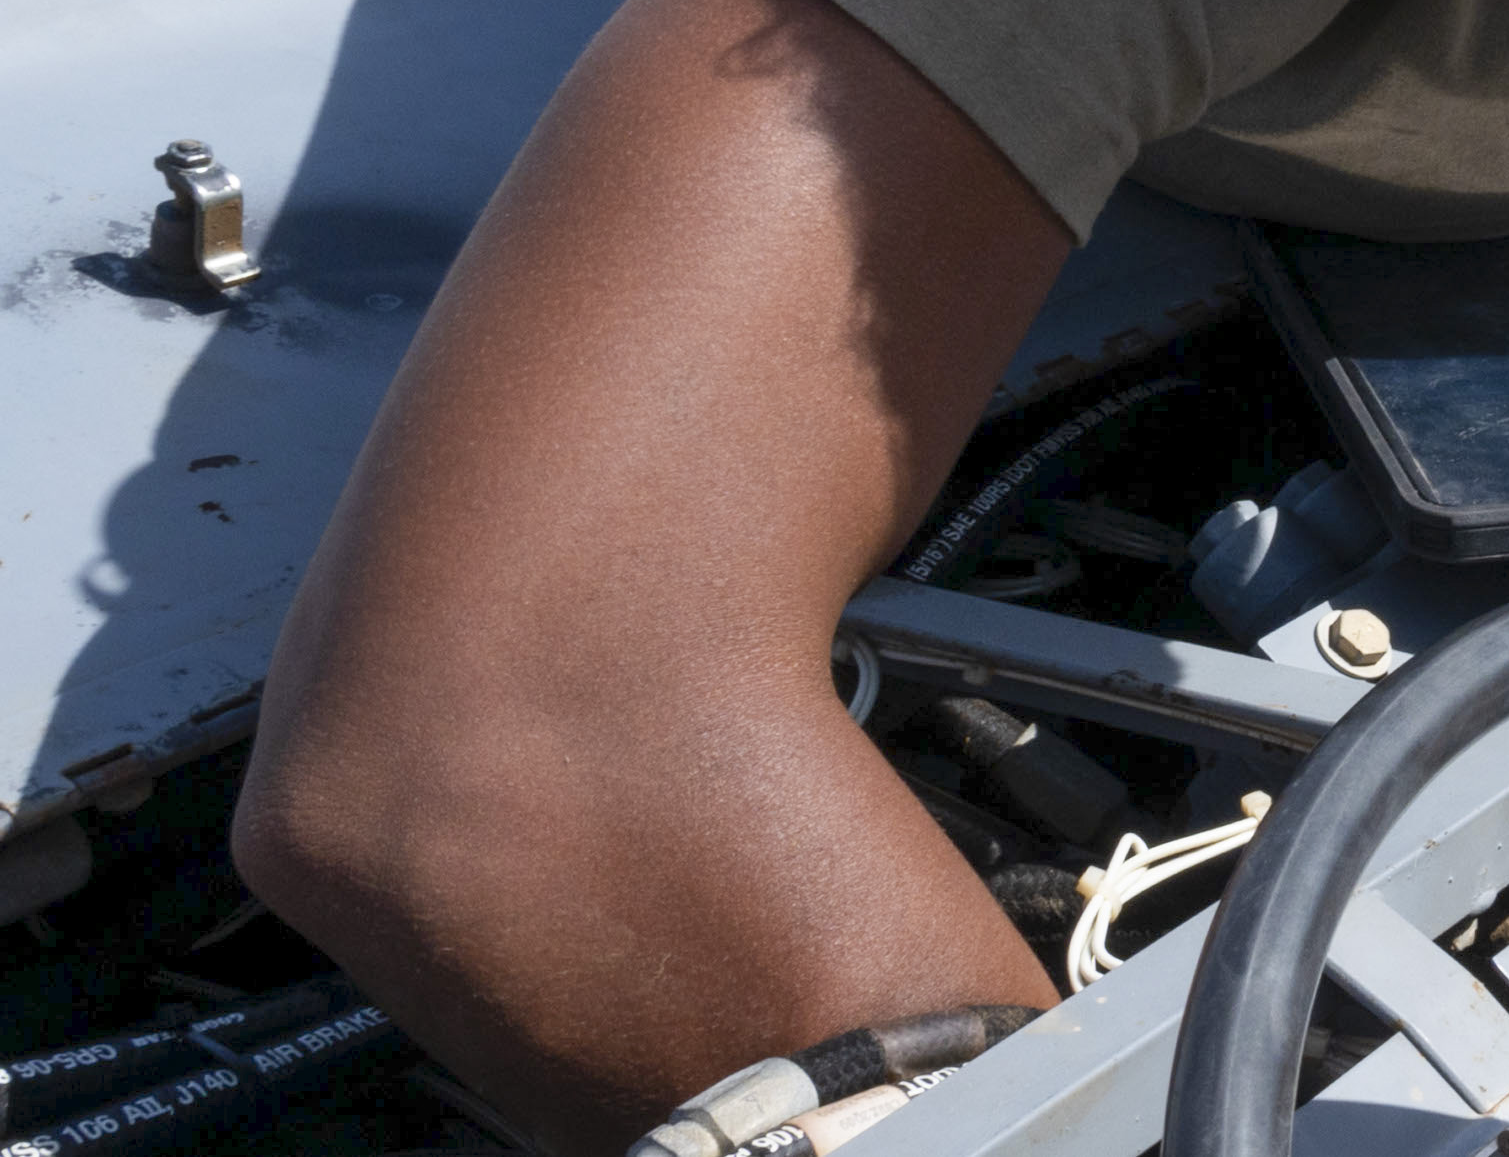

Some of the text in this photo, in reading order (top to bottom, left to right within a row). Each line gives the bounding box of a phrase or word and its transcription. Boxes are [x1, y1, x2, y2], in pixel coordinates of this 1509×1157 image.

[942, 510, 977, 542] SAE
[62, 1113, 121, 1145] 106
[175, 1067, 240, 1106] J140
[250, 1040, 303, 1075] AIR
[298, 1005, 391, 1054] BRAKE
[751, 1124, 805, 1153] 106
